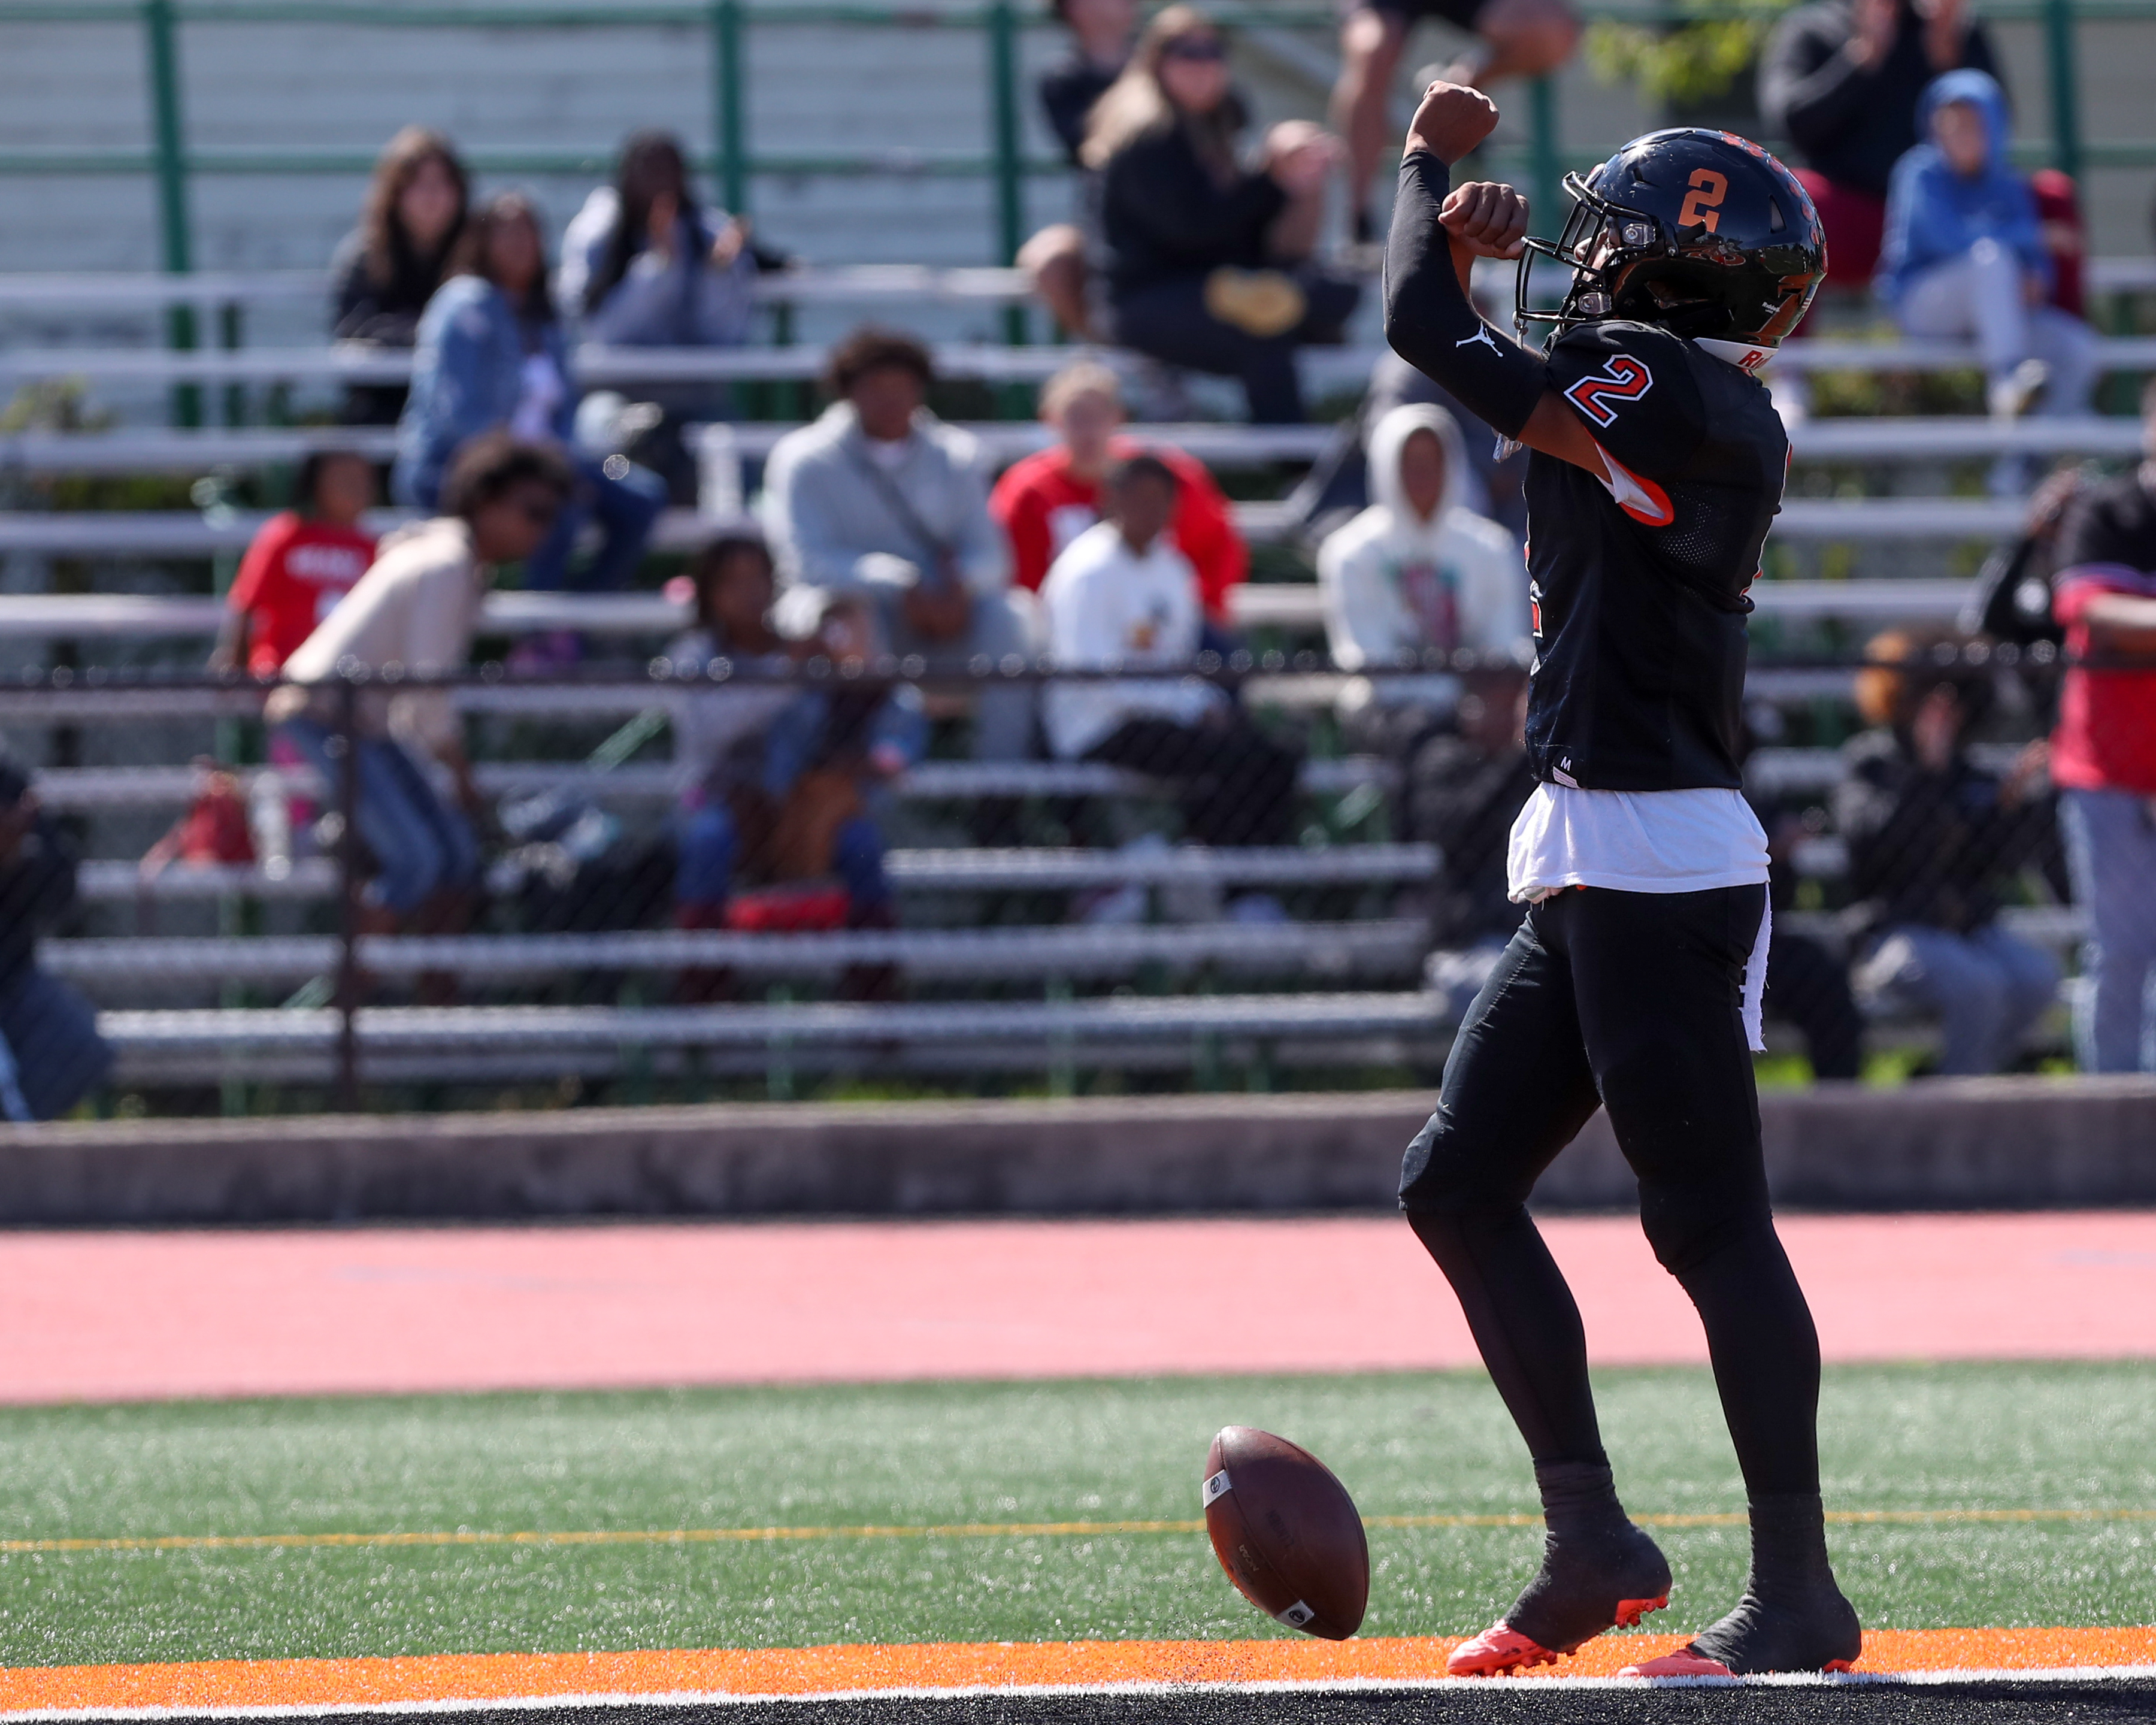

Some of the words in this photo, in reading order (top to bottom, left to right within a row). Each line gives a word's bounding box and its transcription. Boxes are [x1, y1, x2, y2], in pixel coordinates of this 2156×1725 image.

[1678, 168, 1728, 233] 2
[1564, 354, 1653, 428] 2
[1560, 756, 1571, 771] M
